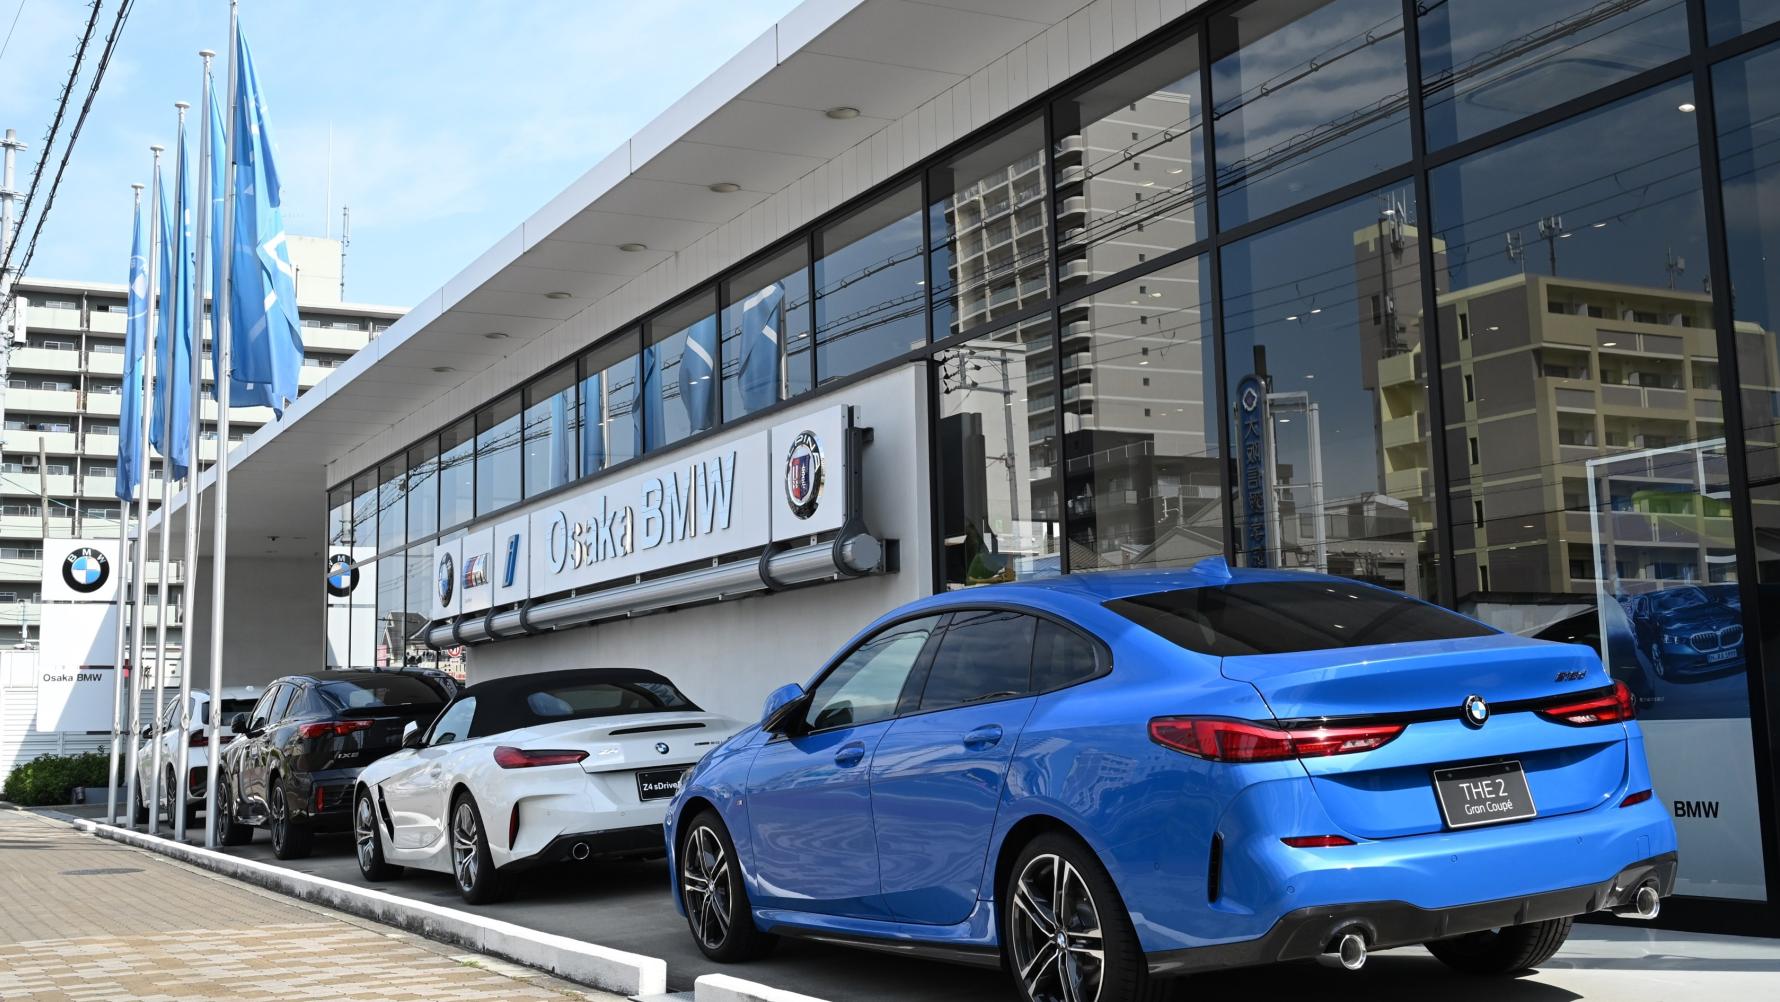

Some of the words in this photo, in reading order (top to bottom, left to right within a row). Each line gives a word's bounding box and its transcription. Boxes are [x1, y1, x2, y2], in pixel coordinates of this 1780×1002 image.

[546, 495, 634, 574] Osaka
[641, 451, 737, 550] BMW
[67, 548, 106, 564] BMW
[43, 673, 74, 682] Osaka
[76, 673, 103, 682] BMW
[642, 783, 653, 791] Z4
[1458, 780, 1496, 801] THE
[1495, 779, 1509, 797] 2
[1464, 804, 1486, 815] Gran
[1486, 799, 1514, 813] Coupé
[1673, 800, 1720, 819] BMW
